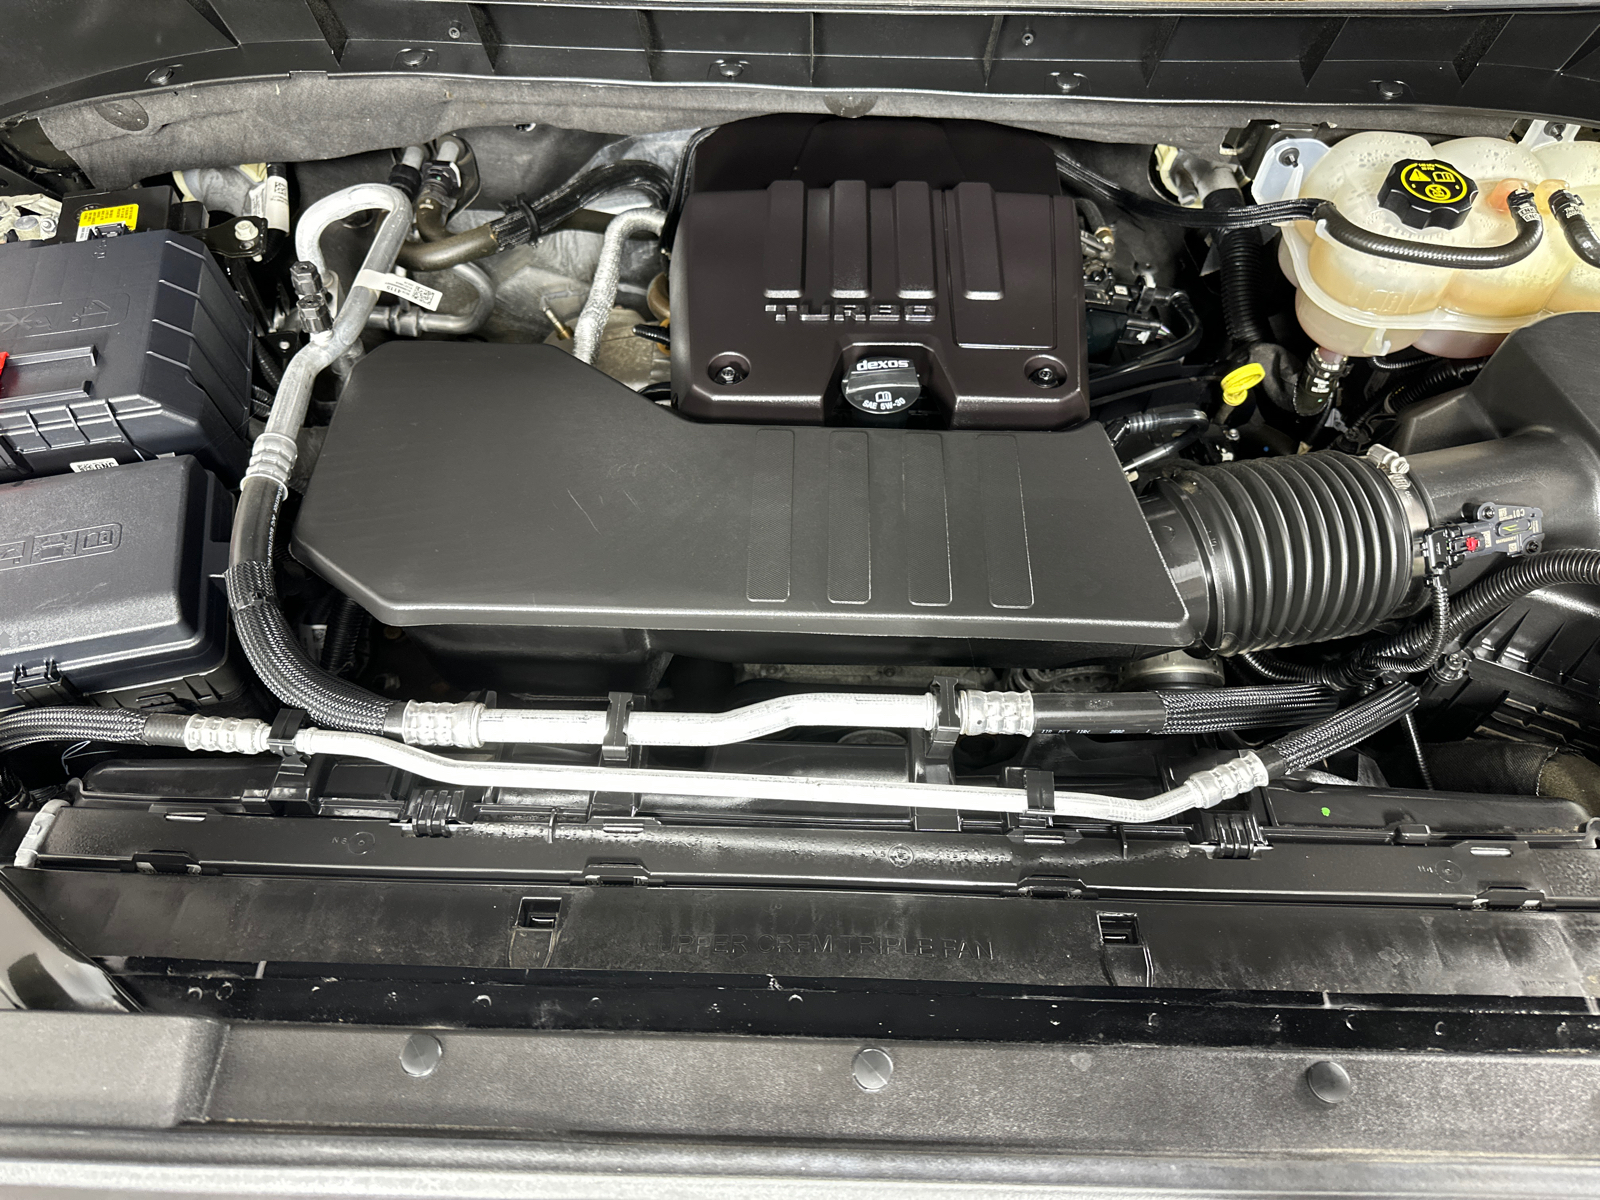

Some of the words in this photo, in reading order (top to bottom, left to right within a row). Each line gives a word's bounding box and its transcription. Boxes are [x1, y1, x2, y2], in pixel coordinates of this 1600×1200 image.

[856, 359, 910, 371] dexos
[862, 399, 878, 410] SAE
[880, 397, 906, 410] 5W-30
[658, 933, 749, 954] UPPER
[757, 933, 833, 954] CRFM
[839, 934, 937, 957] TRIPLE
[940, 938, 994, 960] FAN
